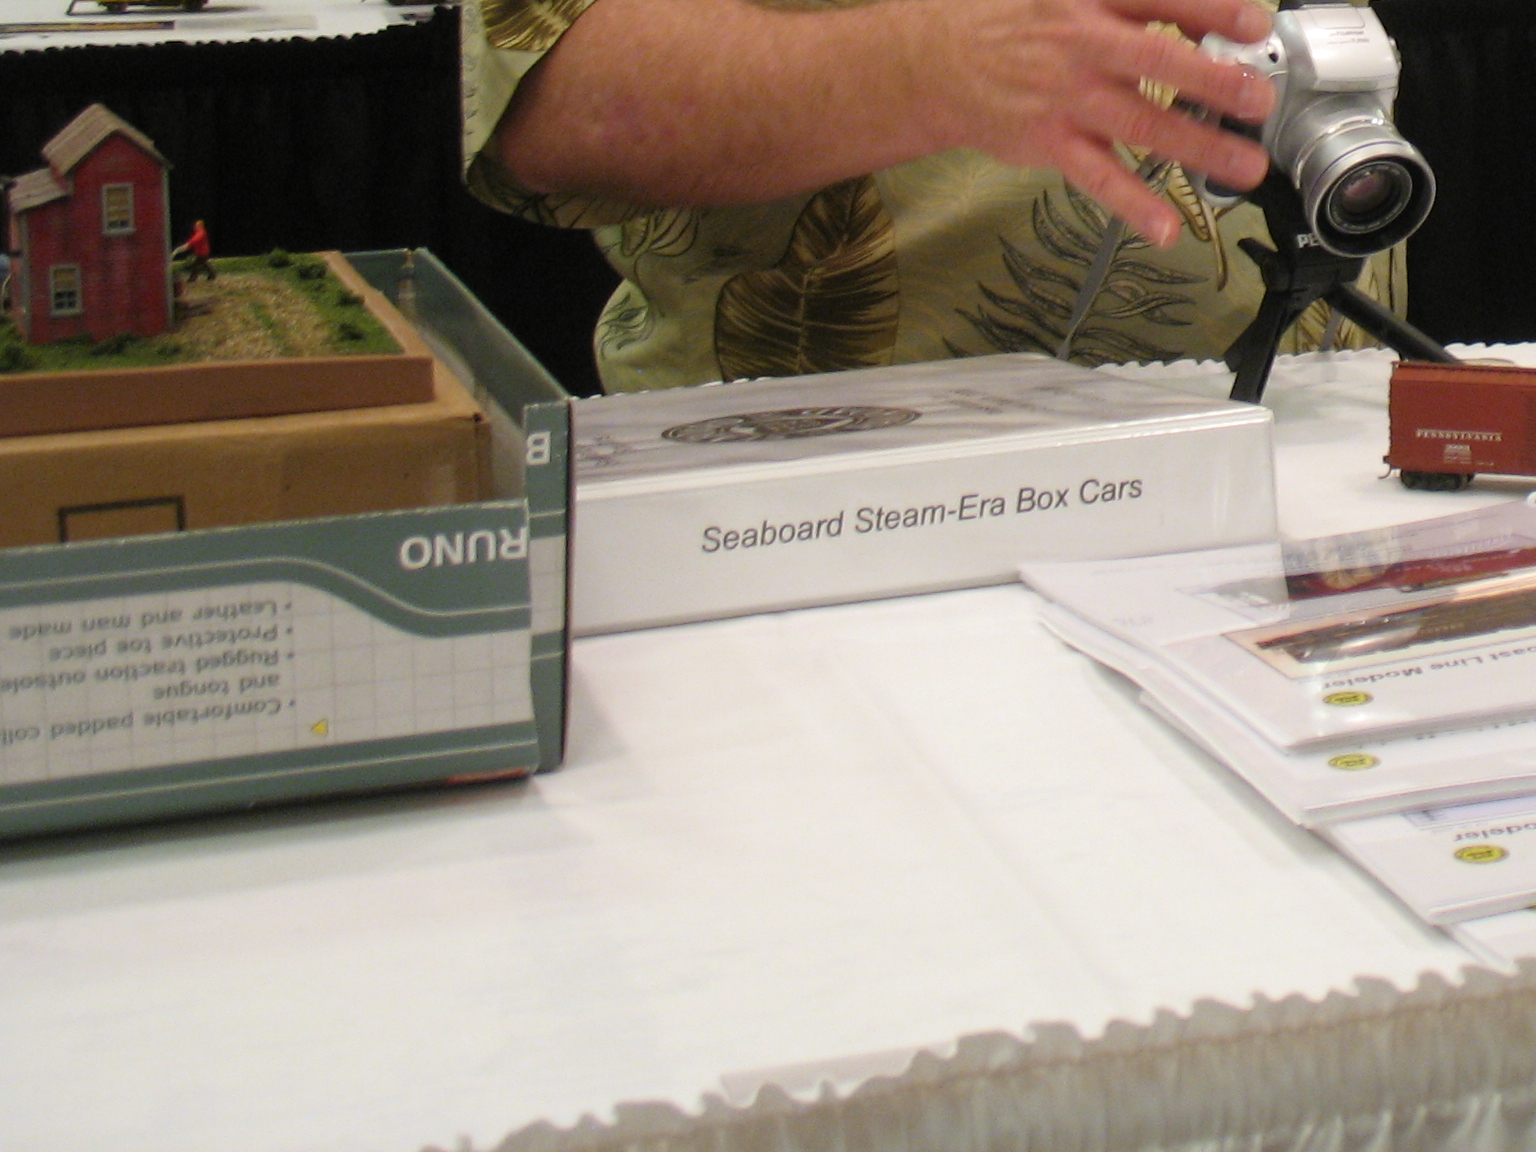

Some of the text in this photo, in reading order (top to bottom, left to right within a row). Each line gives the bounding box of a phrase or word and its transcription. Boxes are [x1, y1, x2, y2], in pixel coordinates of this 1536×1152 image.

[701, 477, 1144, 554] Seaboard Steam-Era Box Cars
[399, 526, 529, 570] RUNO
[9, 599, 277, 641] Leather and man made
[50, 623, 278, 662] Protective toe piece
[94, 659, 186, 682] traction
[196, 648, 278, 673] Rugged
[1429, 654, 1484, 671] Line
[153, 673, 280, 699] and tongue
[1324, 665, 1423, 689] Modeler
[51, 711, 134, 740] padded
[144, 698, 282, 727] Comfortable
